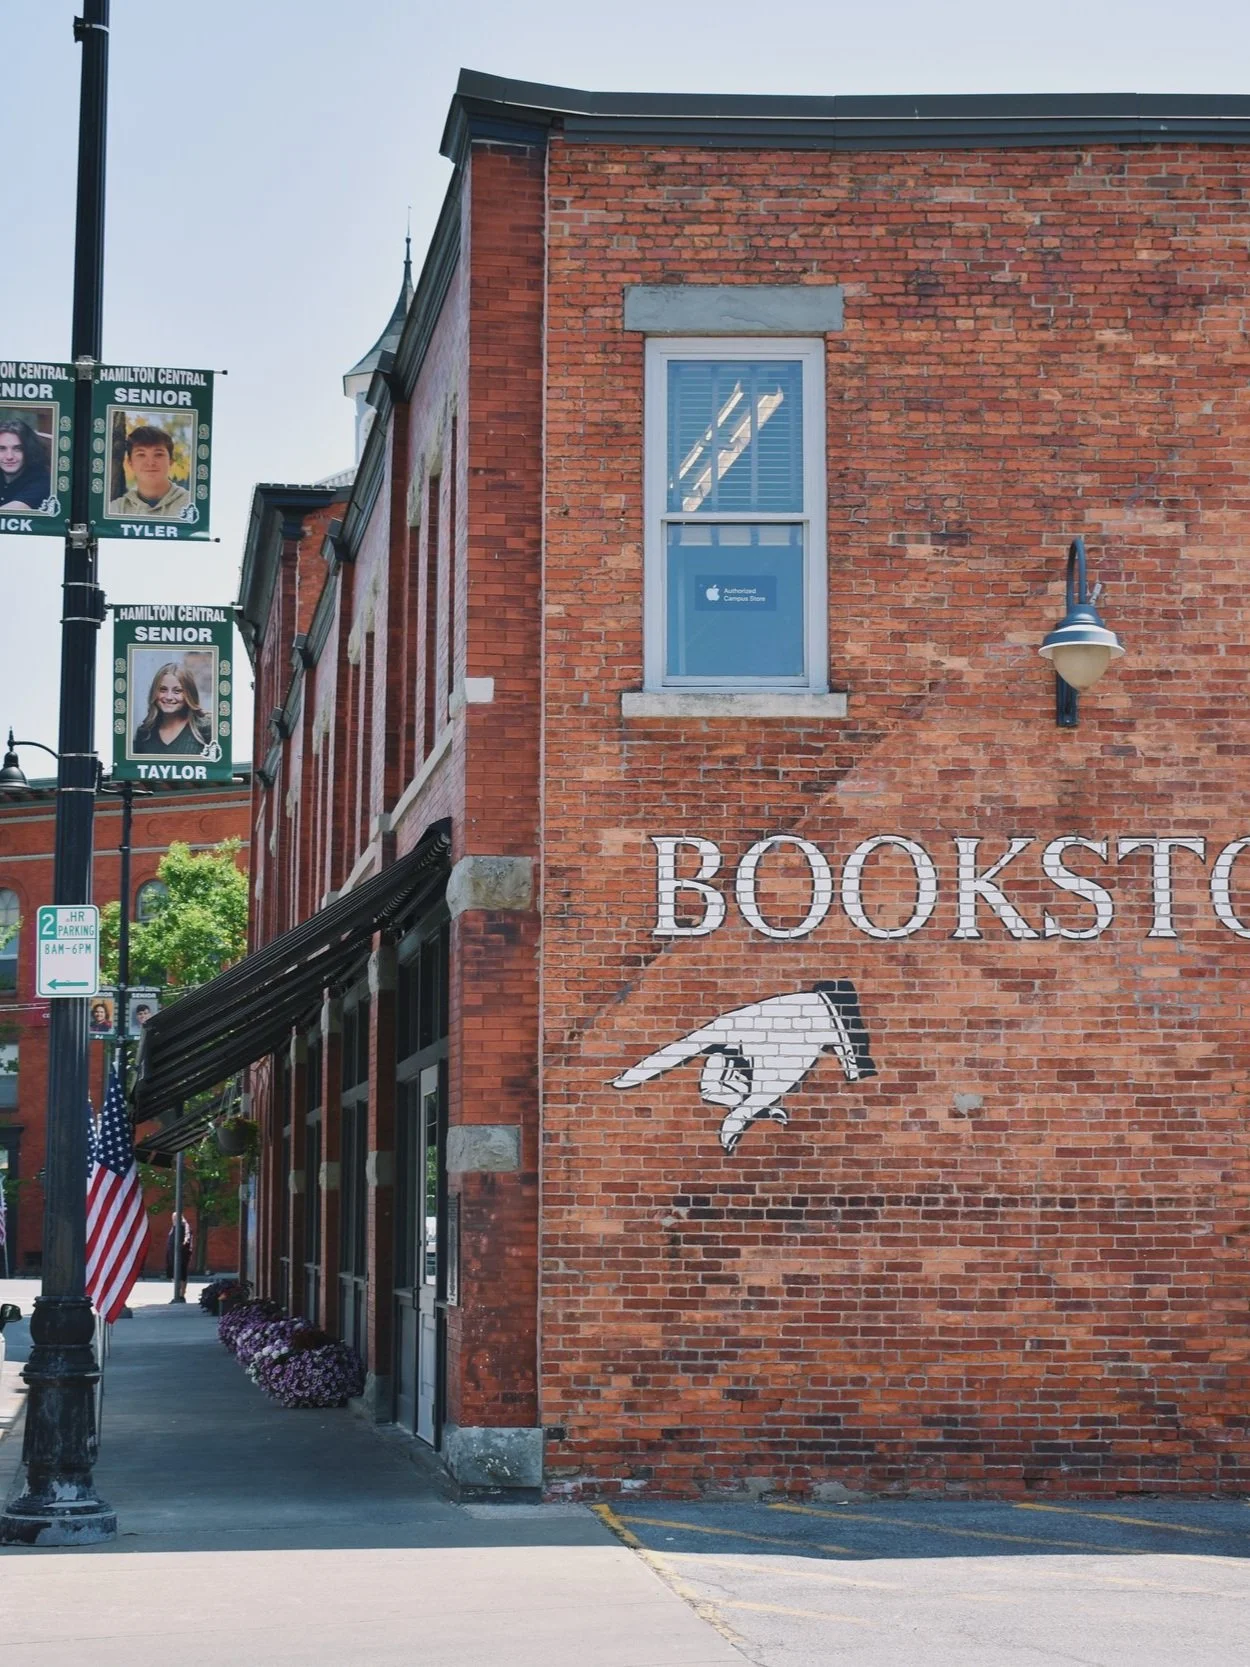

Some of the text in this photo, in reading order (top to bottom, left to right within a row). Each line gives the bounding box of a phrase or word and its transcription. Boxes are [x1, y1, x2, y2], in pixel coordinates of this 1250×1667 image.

[19, 362, 69, 380] CENTRAL
[100, 367, 207, 386] HAMILTON CENTRAL
[0, 382, 54, 399] NIOR
[114, 387, 192, 406] SENIOR
[120, 524, 178, 538] TYLER
[120, 605, 227, 622] HAMILTON CENTRAL
[134, 626, 213, 643] SENIOR
[137, 765, 207, 780] TAYLOR
[41, 911, 85, 935] 2 HR
[58, 925, 94, 936] PARKING
[44, 943, 92, 955] 8AM-6PM
